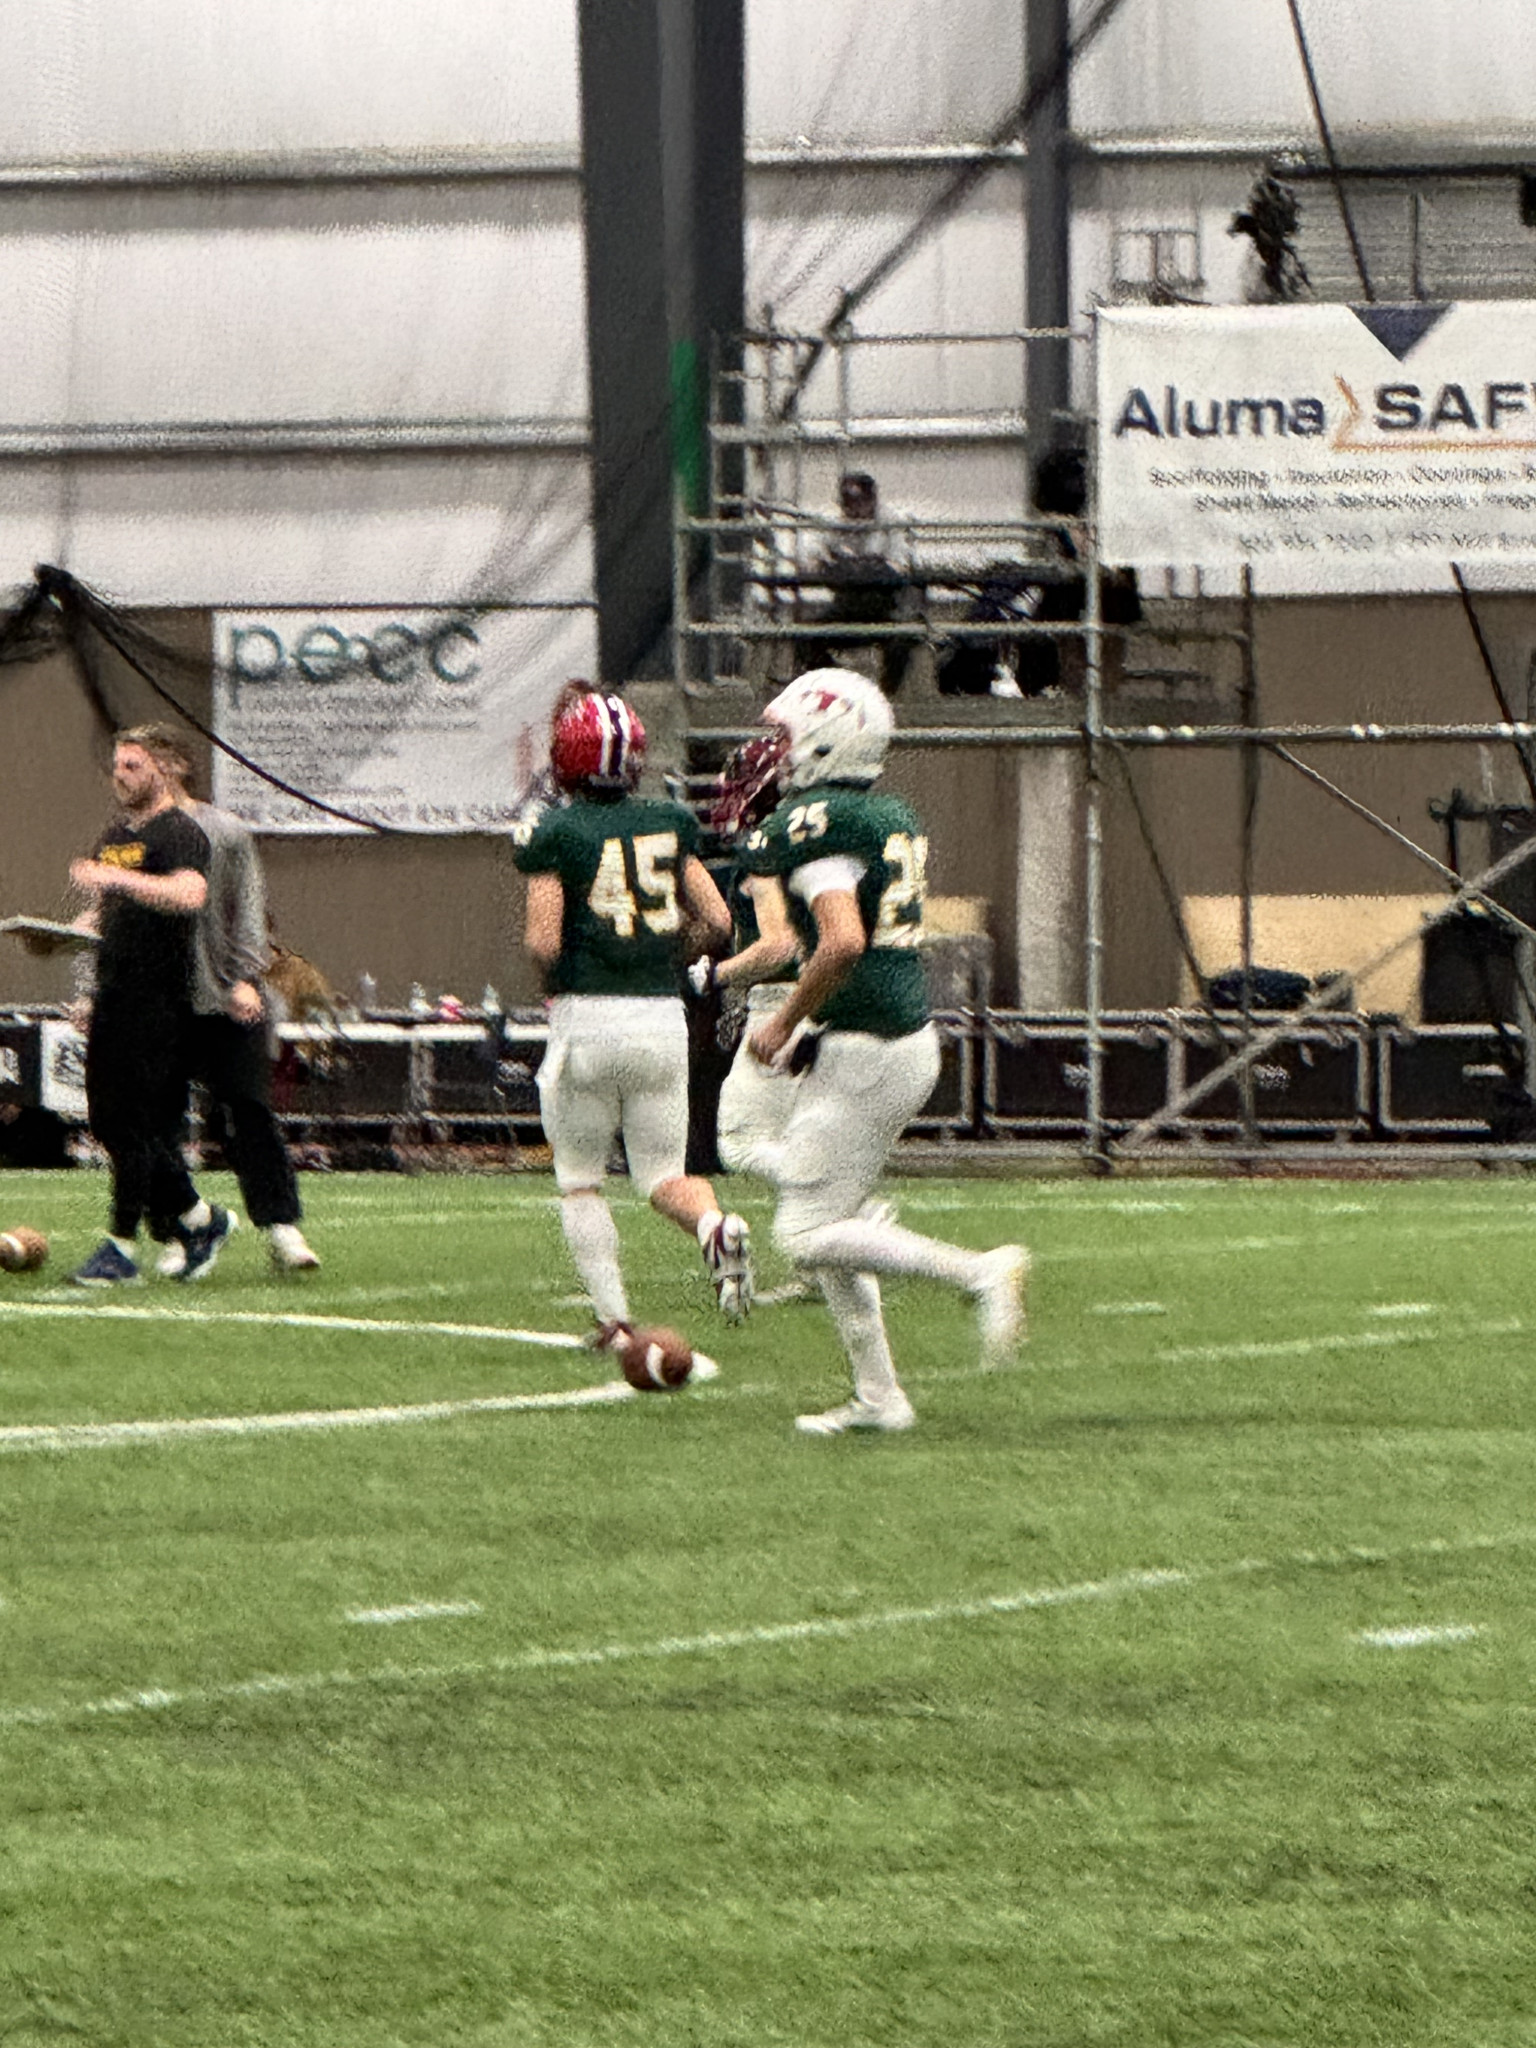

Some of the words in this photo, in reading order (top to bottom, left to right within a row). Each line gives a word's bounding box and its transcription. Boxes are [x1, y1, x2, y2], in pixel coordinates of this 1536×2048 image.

[1113, 383, 1327, 438] Aluma
[1373, 382, 1536, 431] SAF
[587, 830, 684, 937] 45
